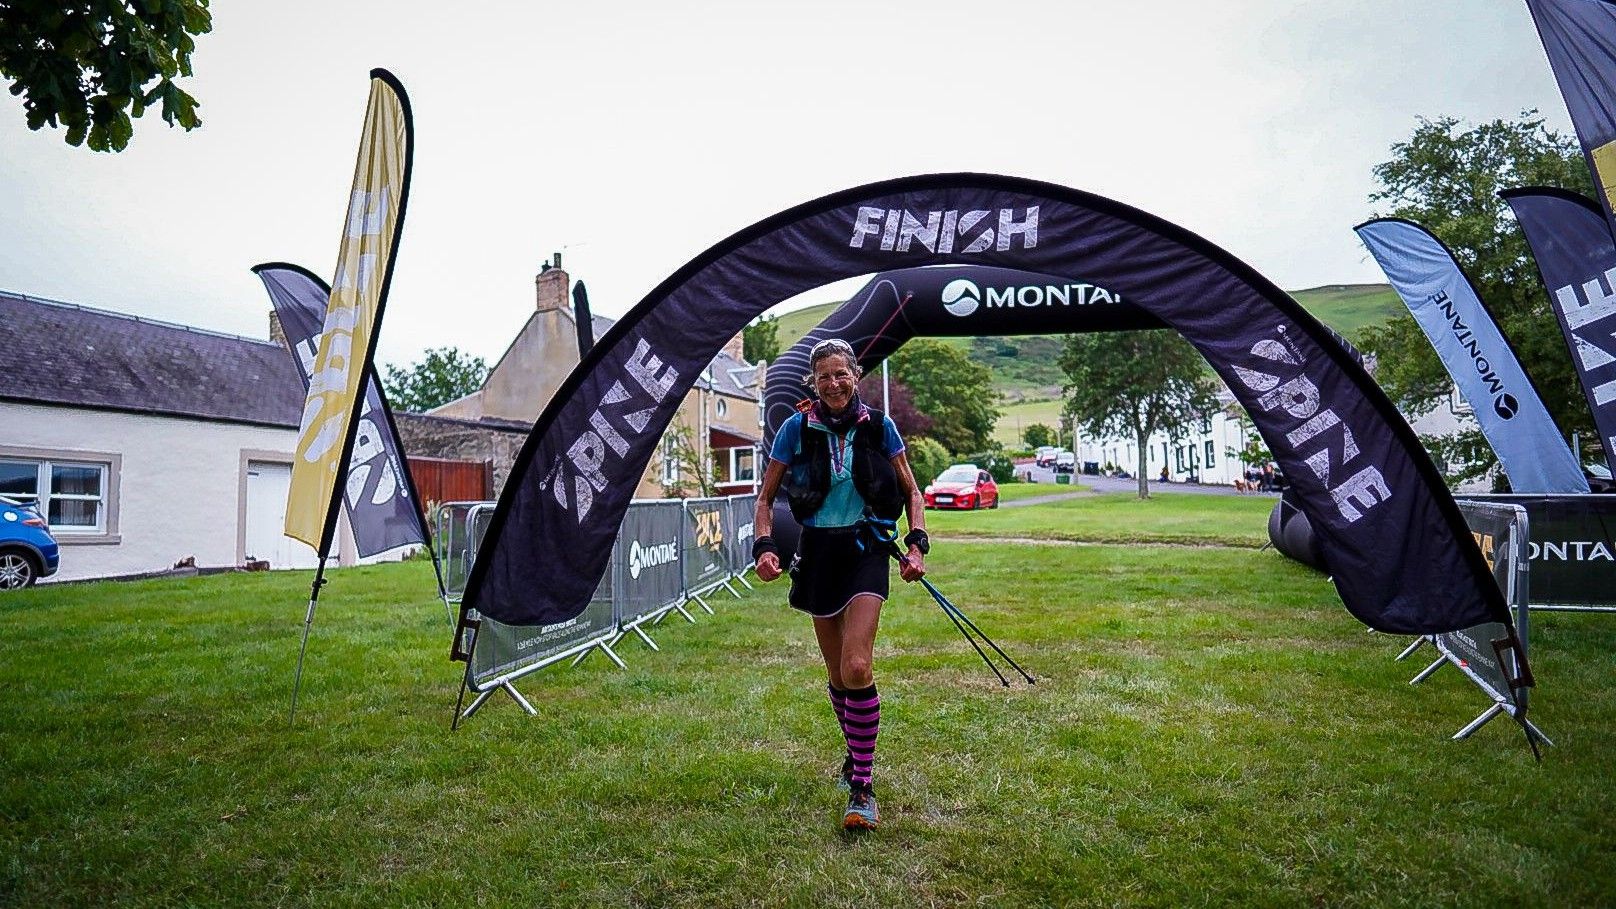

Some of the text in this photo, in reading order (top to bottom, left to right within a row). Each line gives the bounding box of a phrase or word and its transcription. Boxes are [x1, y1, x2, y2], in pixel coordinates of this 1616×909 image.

[850, 205, 1039, 254] FINISH
[986, 284, 1120, 308] MONTA
[553, 337, 680, 524] SPINE
[1230, 339, 1392, 523] SPINE
